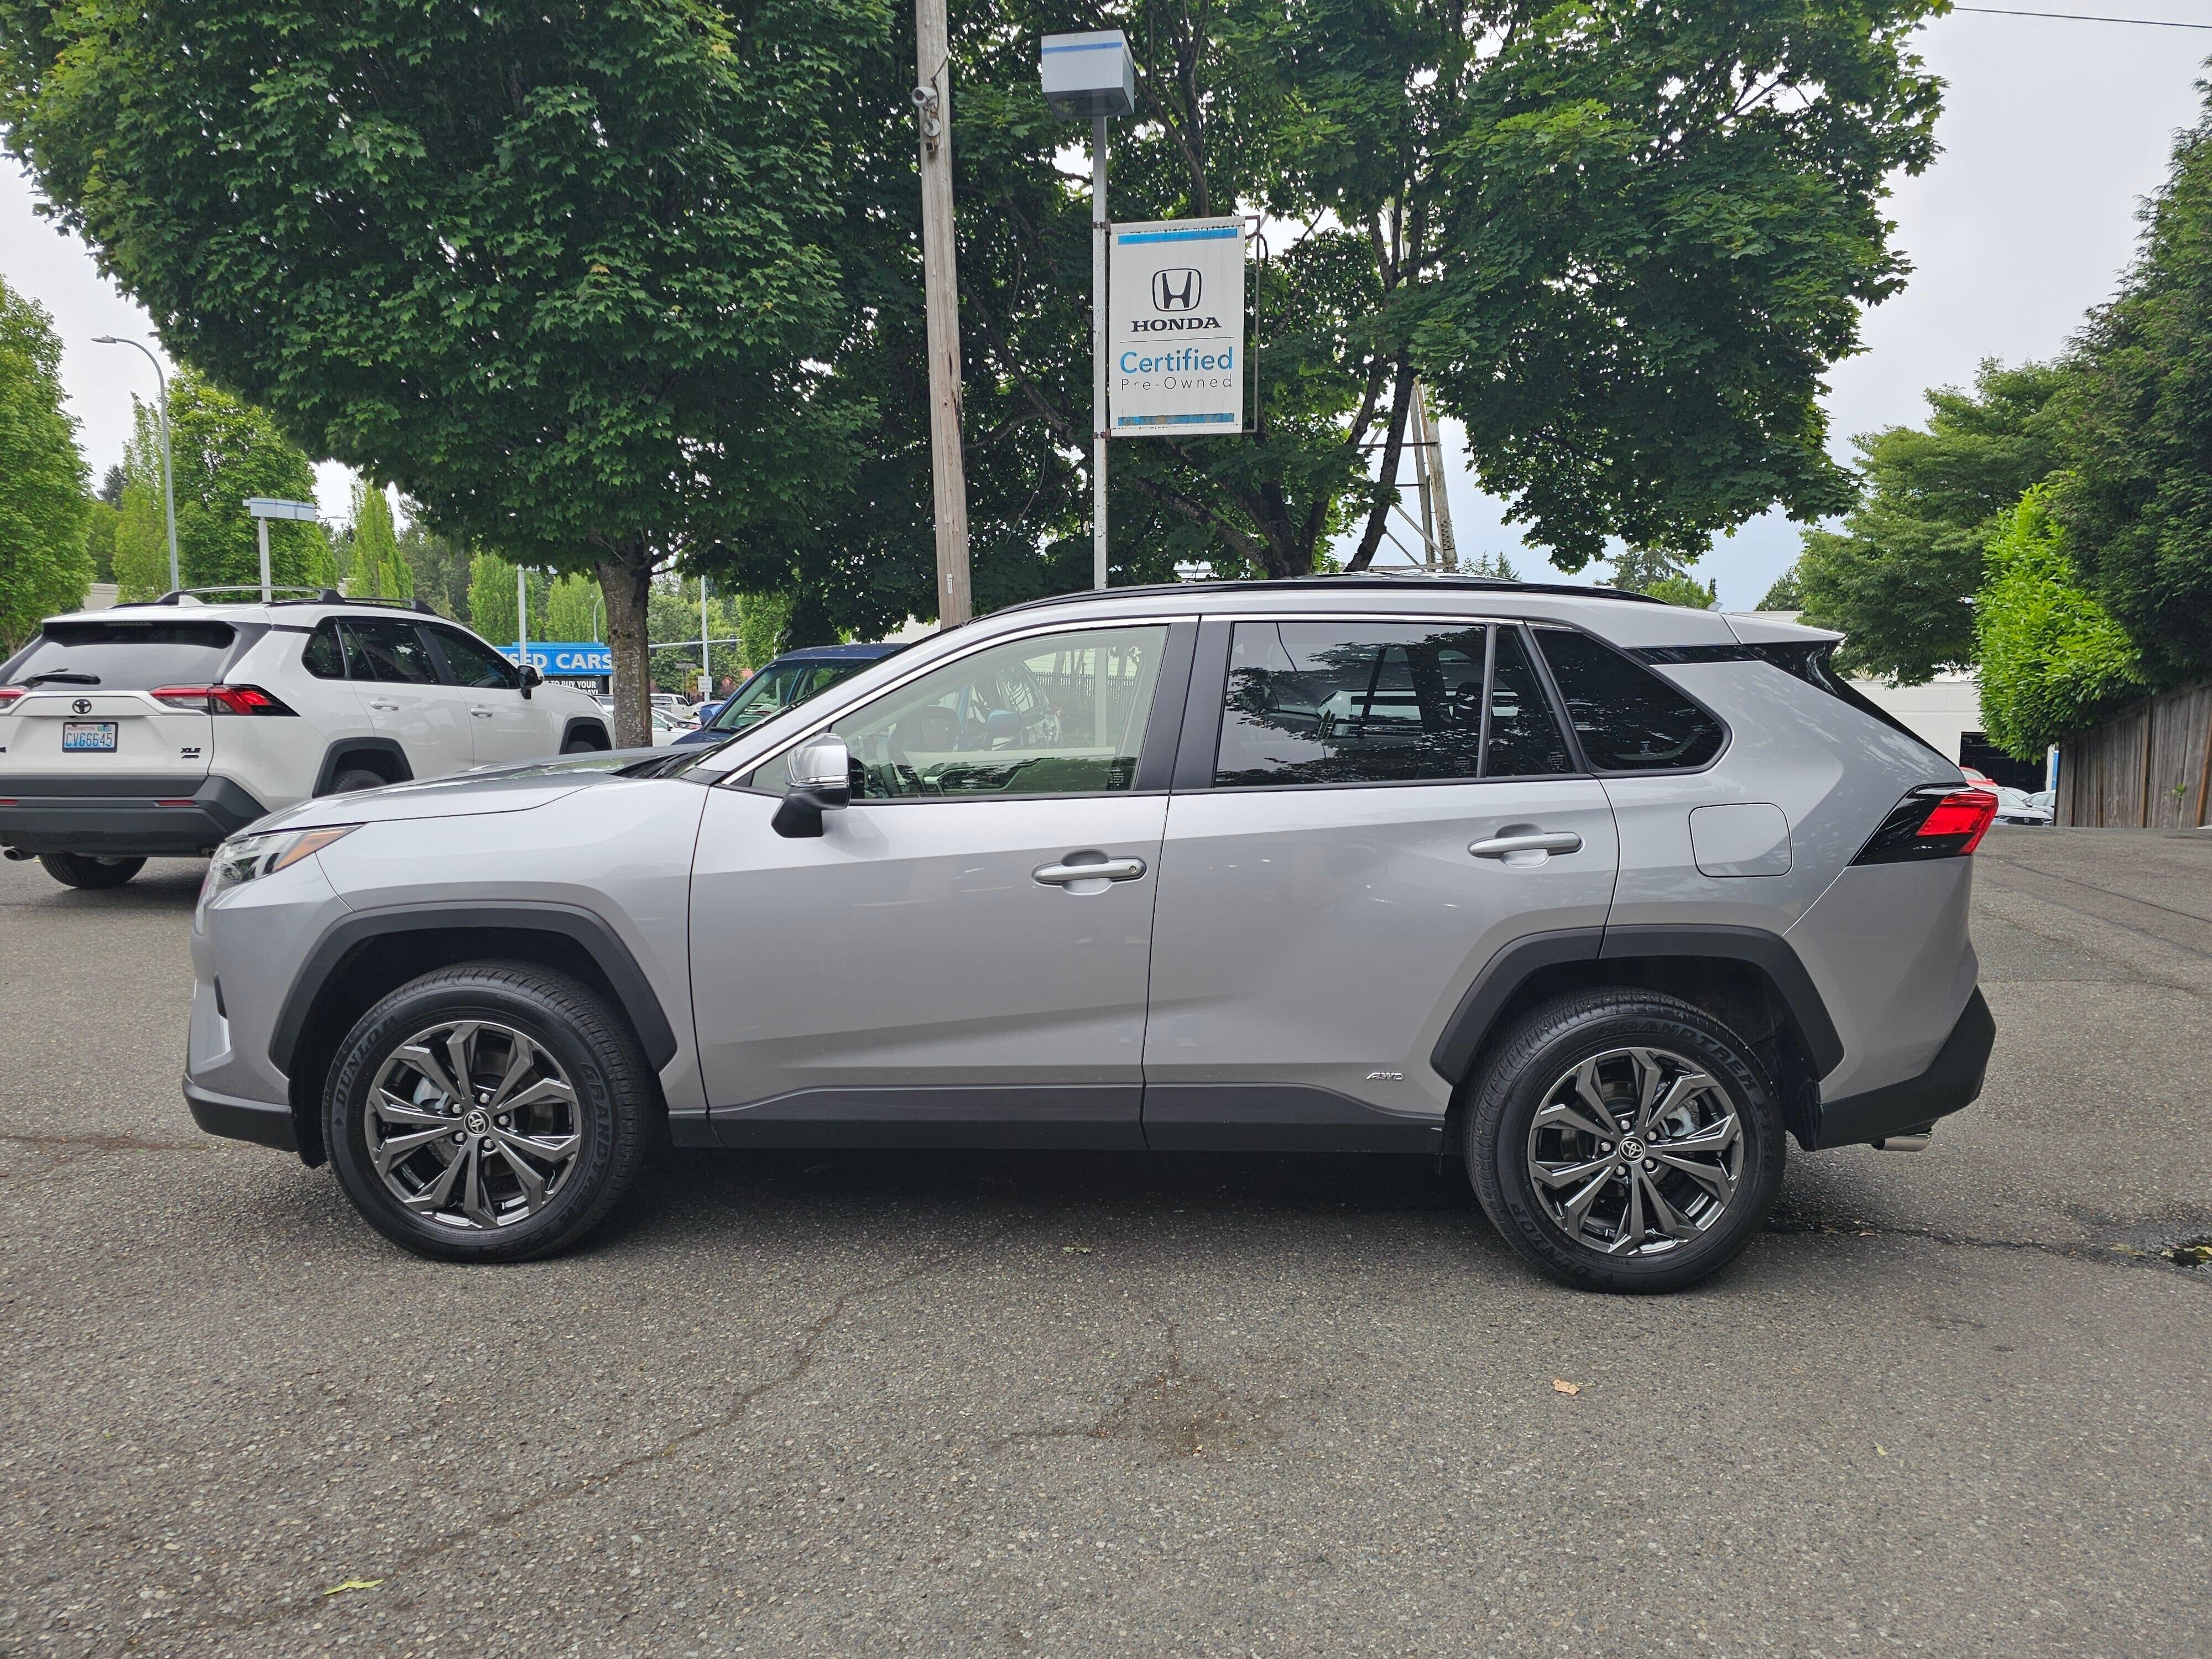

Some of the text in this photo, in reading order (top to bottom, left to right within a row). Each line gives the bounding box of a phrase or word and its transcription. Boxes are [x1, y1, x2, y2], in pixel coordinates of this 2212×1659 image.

[1131, 317, 1222, 332] HONDA
[1120, 346, 1233, 373] Certified
[1121, 374, 1232, 391] Pre-Owned
[556, 654, 612, 669] CARS
[66, 733, 113, 747] CVG6645
